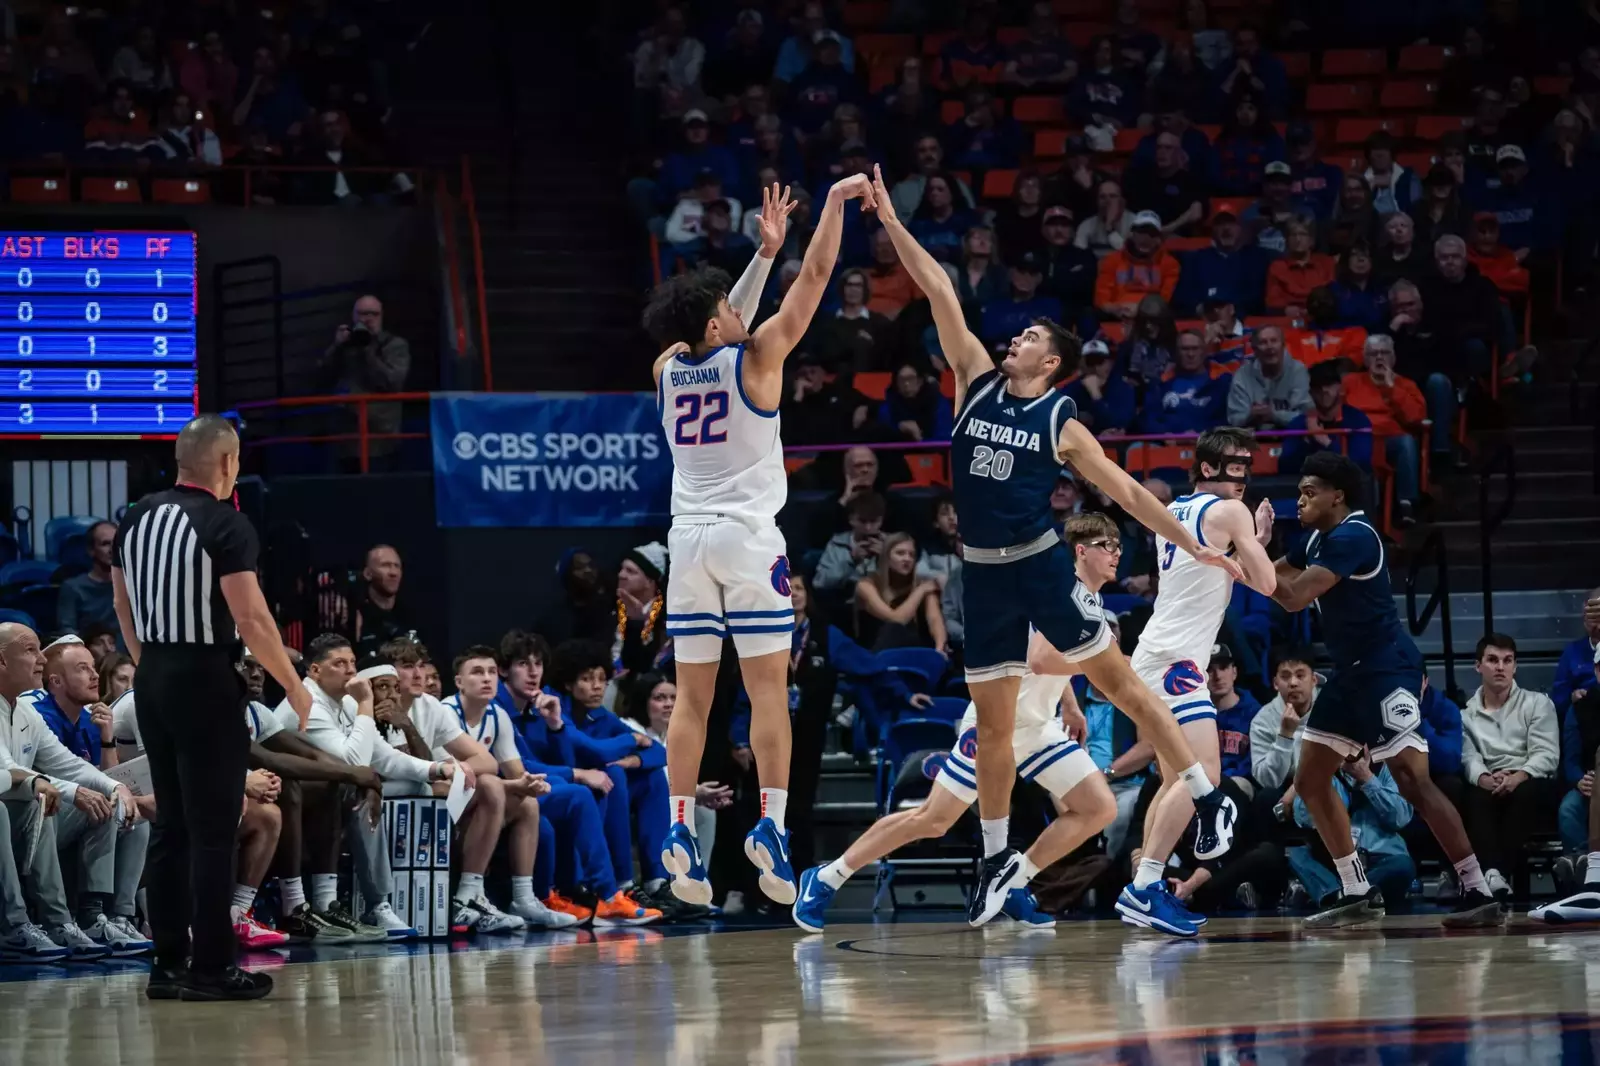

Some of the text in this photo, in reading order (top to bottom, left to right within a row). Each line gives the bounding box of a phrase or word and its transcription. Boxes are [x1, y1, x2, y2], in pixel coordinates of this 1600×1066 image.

[1, 236, 171, 259] AST BLKS PF
[18, 267, 163, 289] 0 0 1
[18, 301, 168, 323] 0 0 0
[18, 335, 168, 357] 0 1 3
[18, 369, 168, 391] 2 0 2
[670, 366, 721, 387] BUCHANAN
[18, 403, 165, 425] 3 1 1
[675, 390, 730, 446] 22
[964, 417, 1041, 452] NEVADA
[479, 432, 660, 460] CBS SPORTS
[969, 445, 1014, 480] 20
[481, 464, 640, 491] NETWORK
